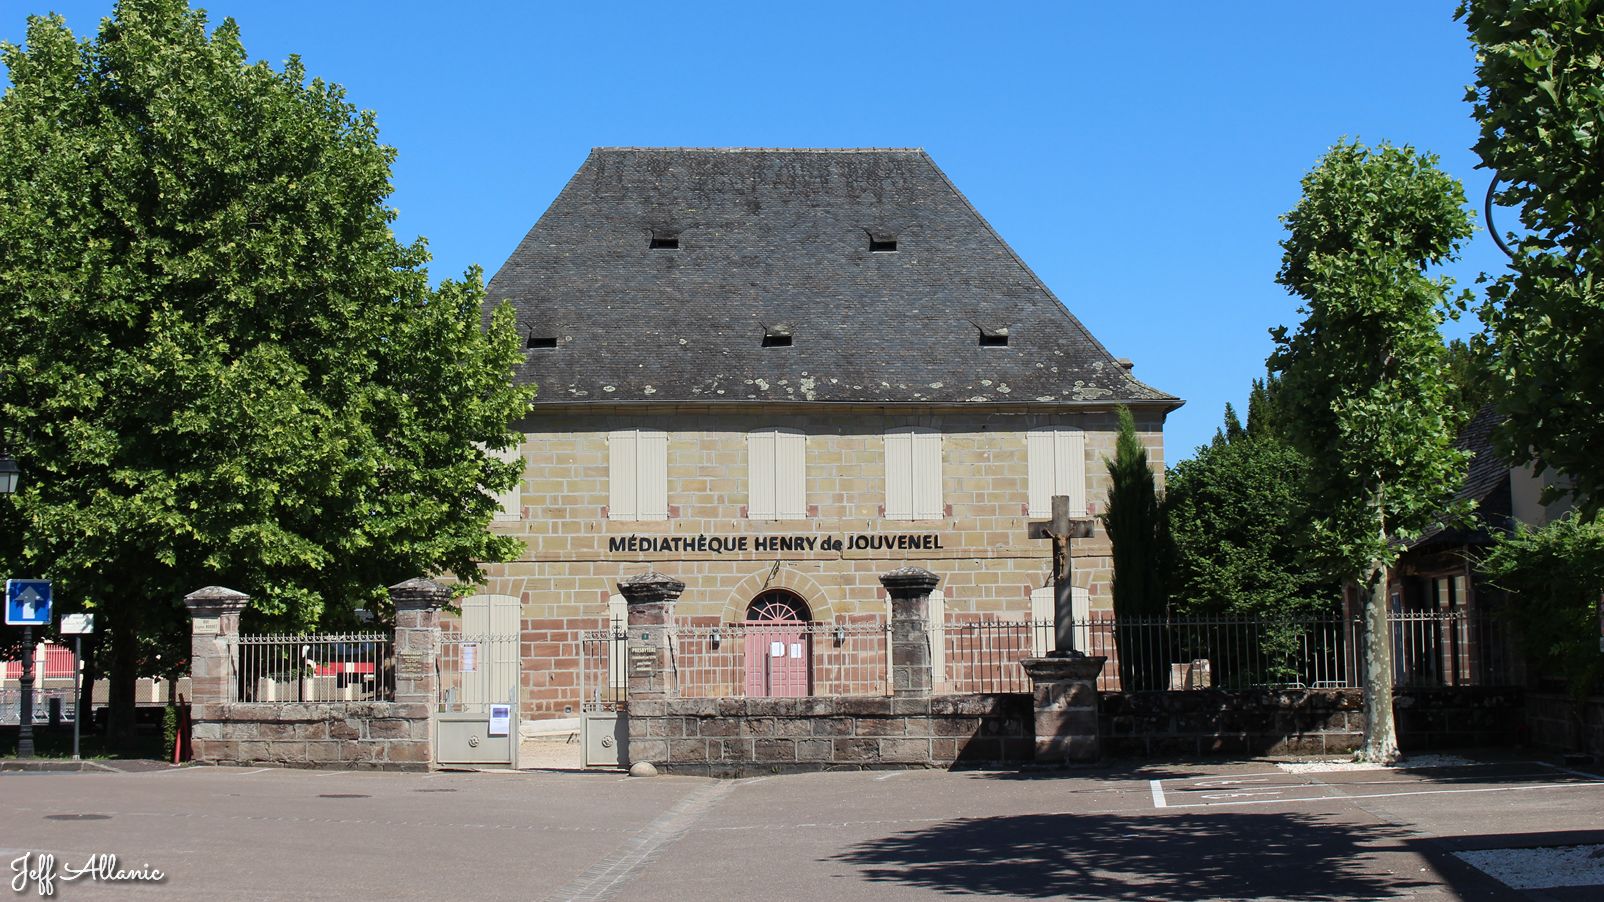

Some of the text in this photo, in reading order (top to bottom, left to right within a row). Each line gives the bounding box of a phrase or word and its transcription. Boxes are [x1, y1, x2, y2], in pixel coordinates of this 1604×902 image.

[609, 534, 944, 554] MÉDIATHÈQUE HENRY de JOUVENEL
